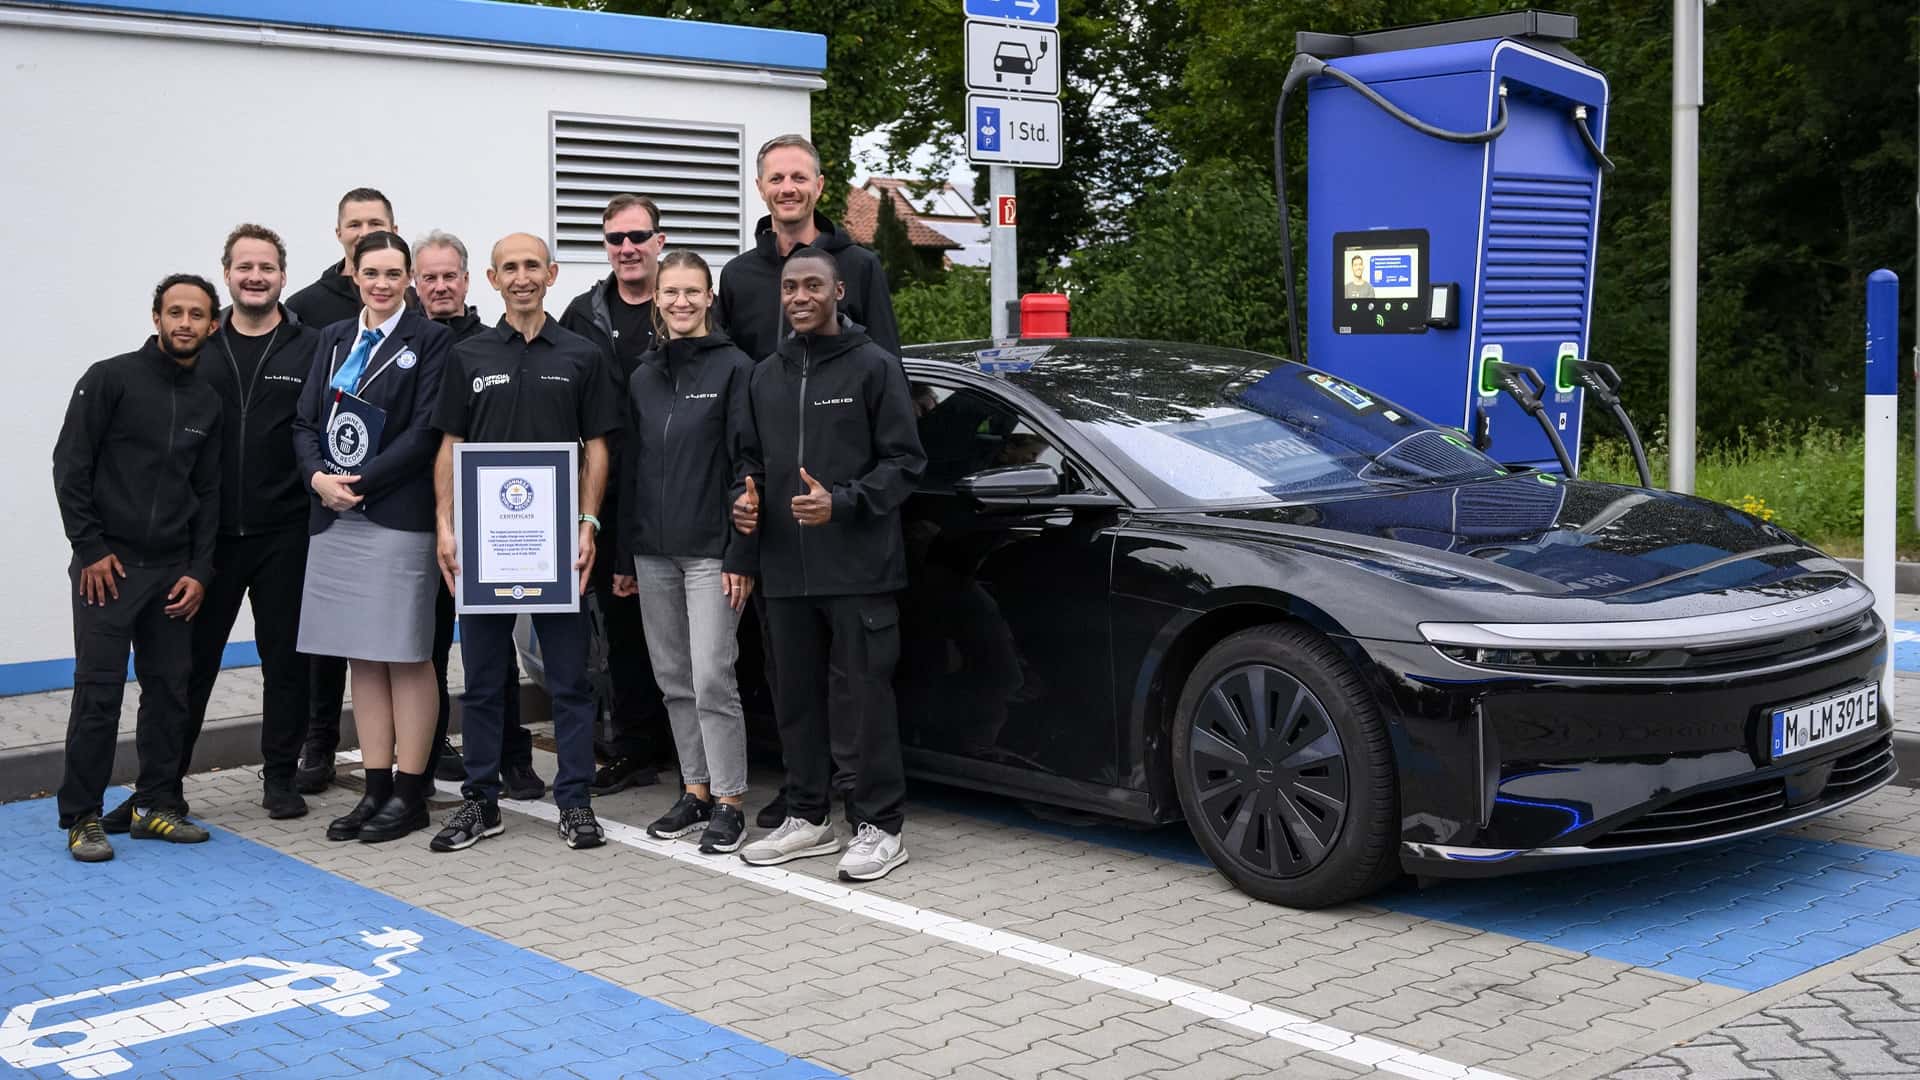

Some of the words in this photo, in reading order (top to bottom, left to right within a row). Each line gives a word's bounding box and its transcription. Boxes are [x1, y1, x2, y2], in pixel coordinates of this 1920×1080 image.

[1009, 121, 1014, 140] 1
[1019, 121, 1050, 143] Std.
[337, 415, 365, 436] GUINNESS
[331, 430, 339, 457] WORLD
[340, 443, 366, 463] RECORDS
[1750, 599, 1833, 622] LUCID
[1775, 739, 1780, 750] D
[1785, 714, 1798, 749] M
